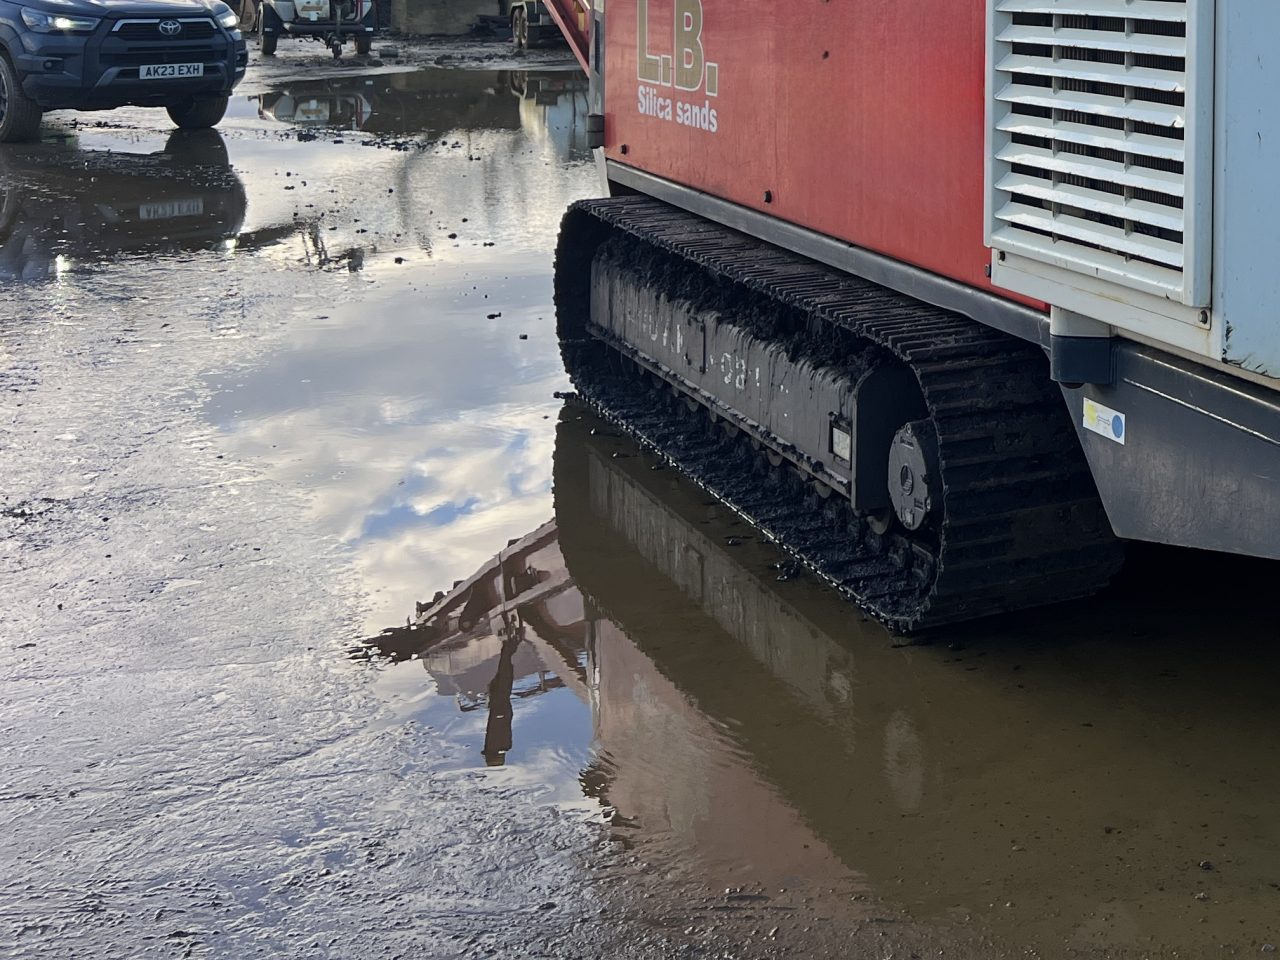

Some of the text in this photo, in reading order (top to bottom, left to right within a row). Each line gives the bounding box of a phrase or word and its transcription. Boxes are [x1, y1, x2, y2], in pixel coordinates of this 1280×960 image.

[145, 64, 200, 77] AK23 EXH
[638, 85, 718, 133] Silica sands
